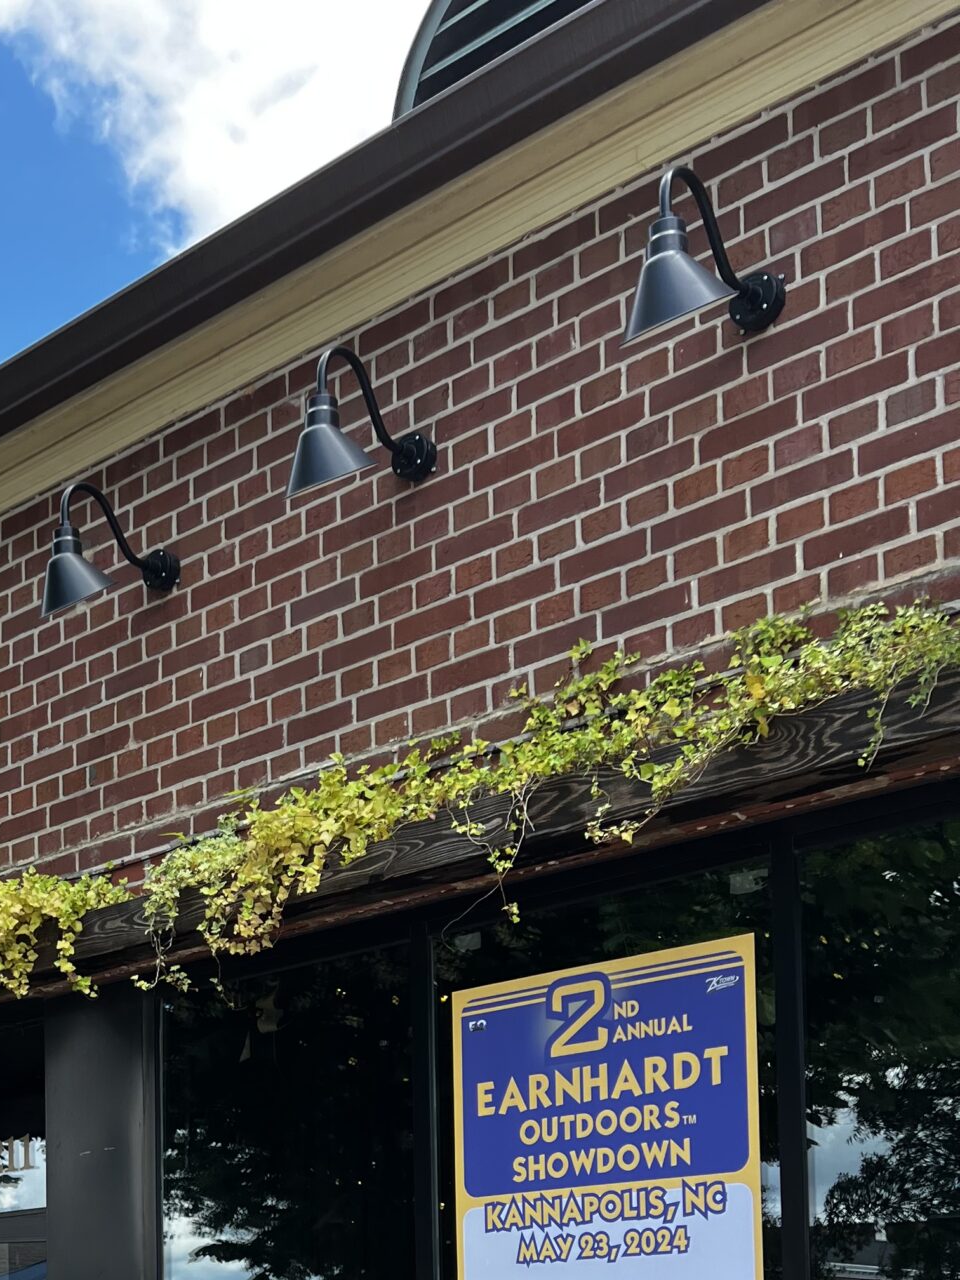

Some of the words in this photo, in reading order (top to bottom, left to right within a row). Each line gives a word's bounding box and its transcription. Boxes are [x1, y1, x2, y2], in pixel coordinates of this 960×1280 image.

[549, 977, 609, 1059] 2
[613, 999, 640, 1020] ND
[612, 1013, 693, 1043] ANNUAL
[476, 1045, 729, 1117] EARNHARDT
[518, 1101, 680, 1146] OUTDOORS
[512, 1137, 691, 1183] SHOWDOWN
[485, 1184, 679, 1233] KANNAPOLIS,
[682, 1180, 727, 1220] NC
[516, 1231, 576, 1267] MAY
[577, 1231, 620, 1263] 23,
[621, 1225, 690, 1257] 2024
